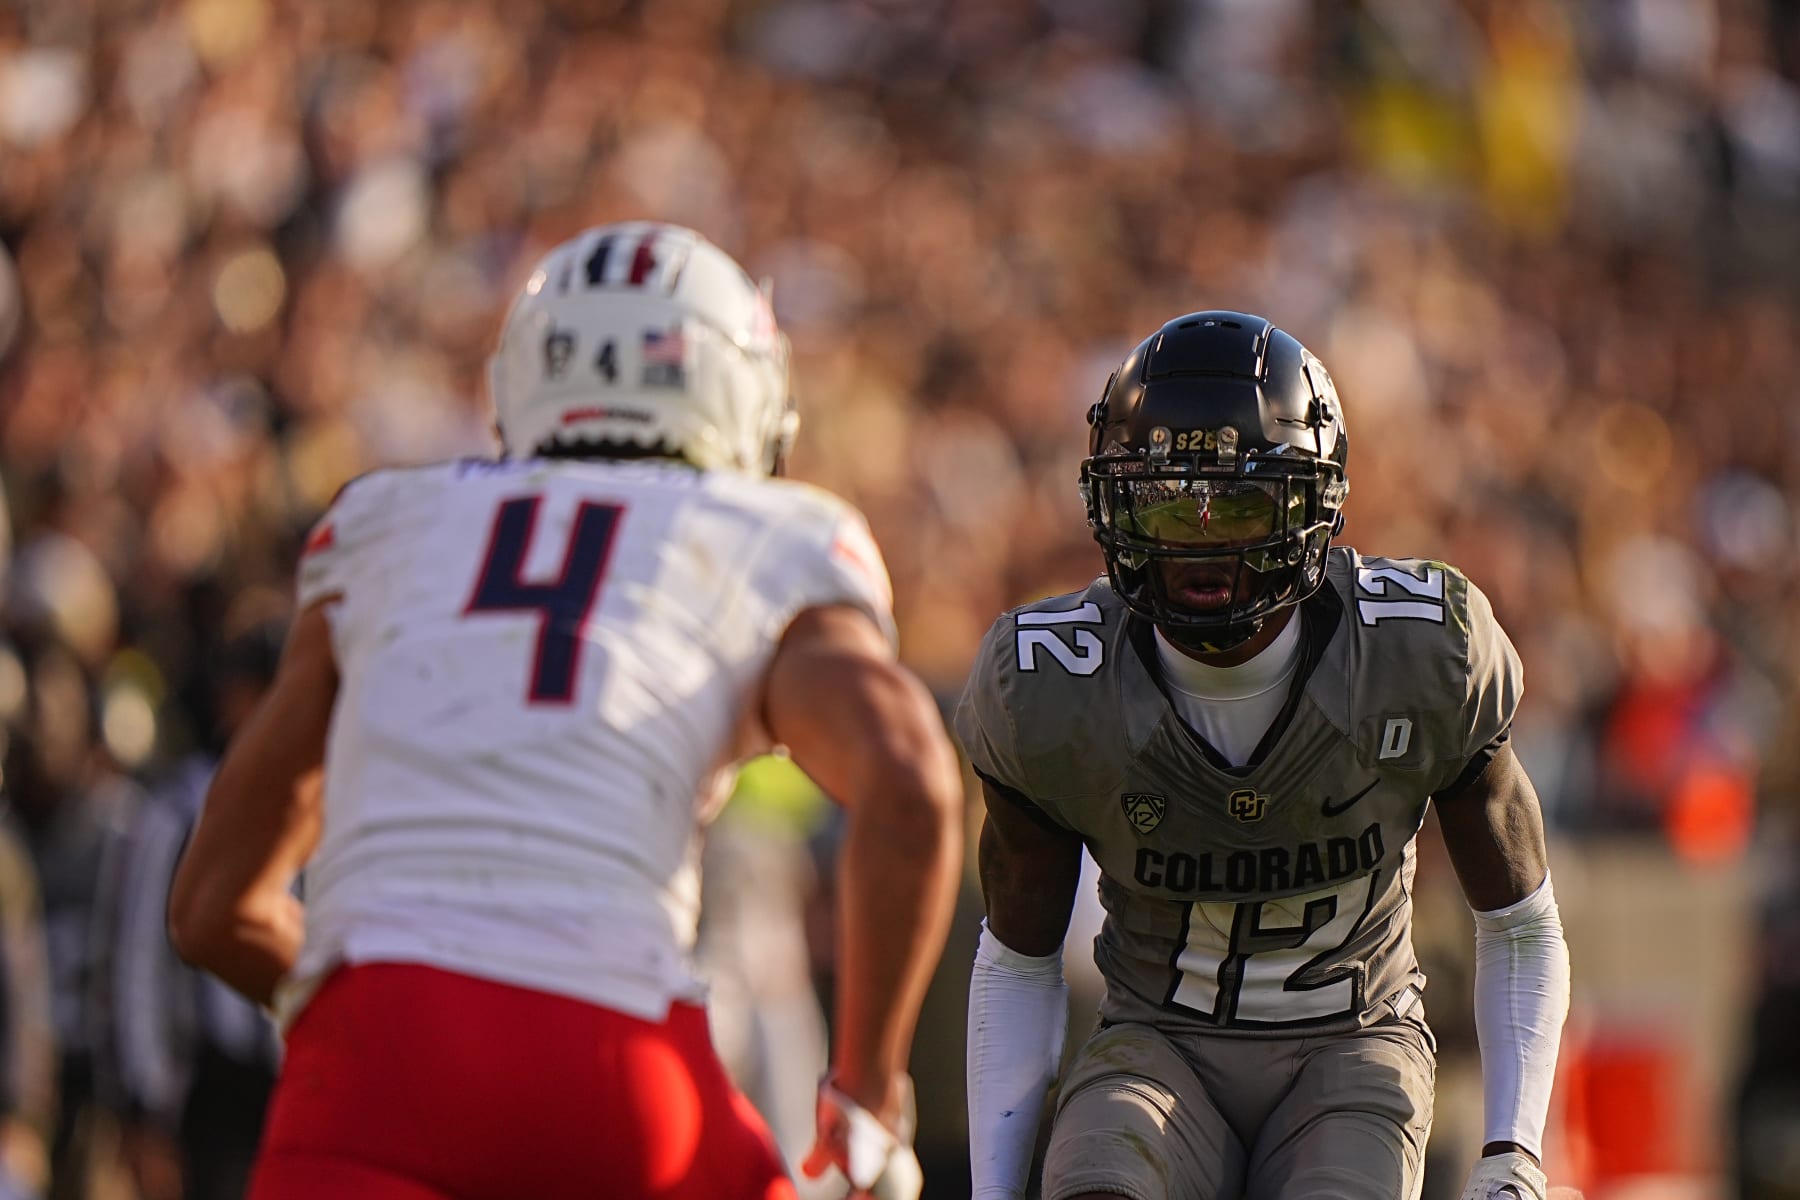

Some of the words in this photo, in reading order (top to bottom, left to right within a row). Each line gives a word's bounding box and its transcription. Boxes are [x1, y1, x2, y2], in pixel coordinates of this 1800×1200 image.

[594, 337, 618, 384] 4
[462, 494, 628, 706] 4
[1356, 567, 1445, 627] 12
[1015, 600, 1105, 678] 12
[1379, 718, 1413, 760] D
[1122, 794, 1165, 819] PAC
[1132, 811, 1154, 827] 12
[1229, 790, 1268, 823] CU
[1134, 822, 1385, 892] COLORADO
[1164, 869, 1378, 1031] 12
